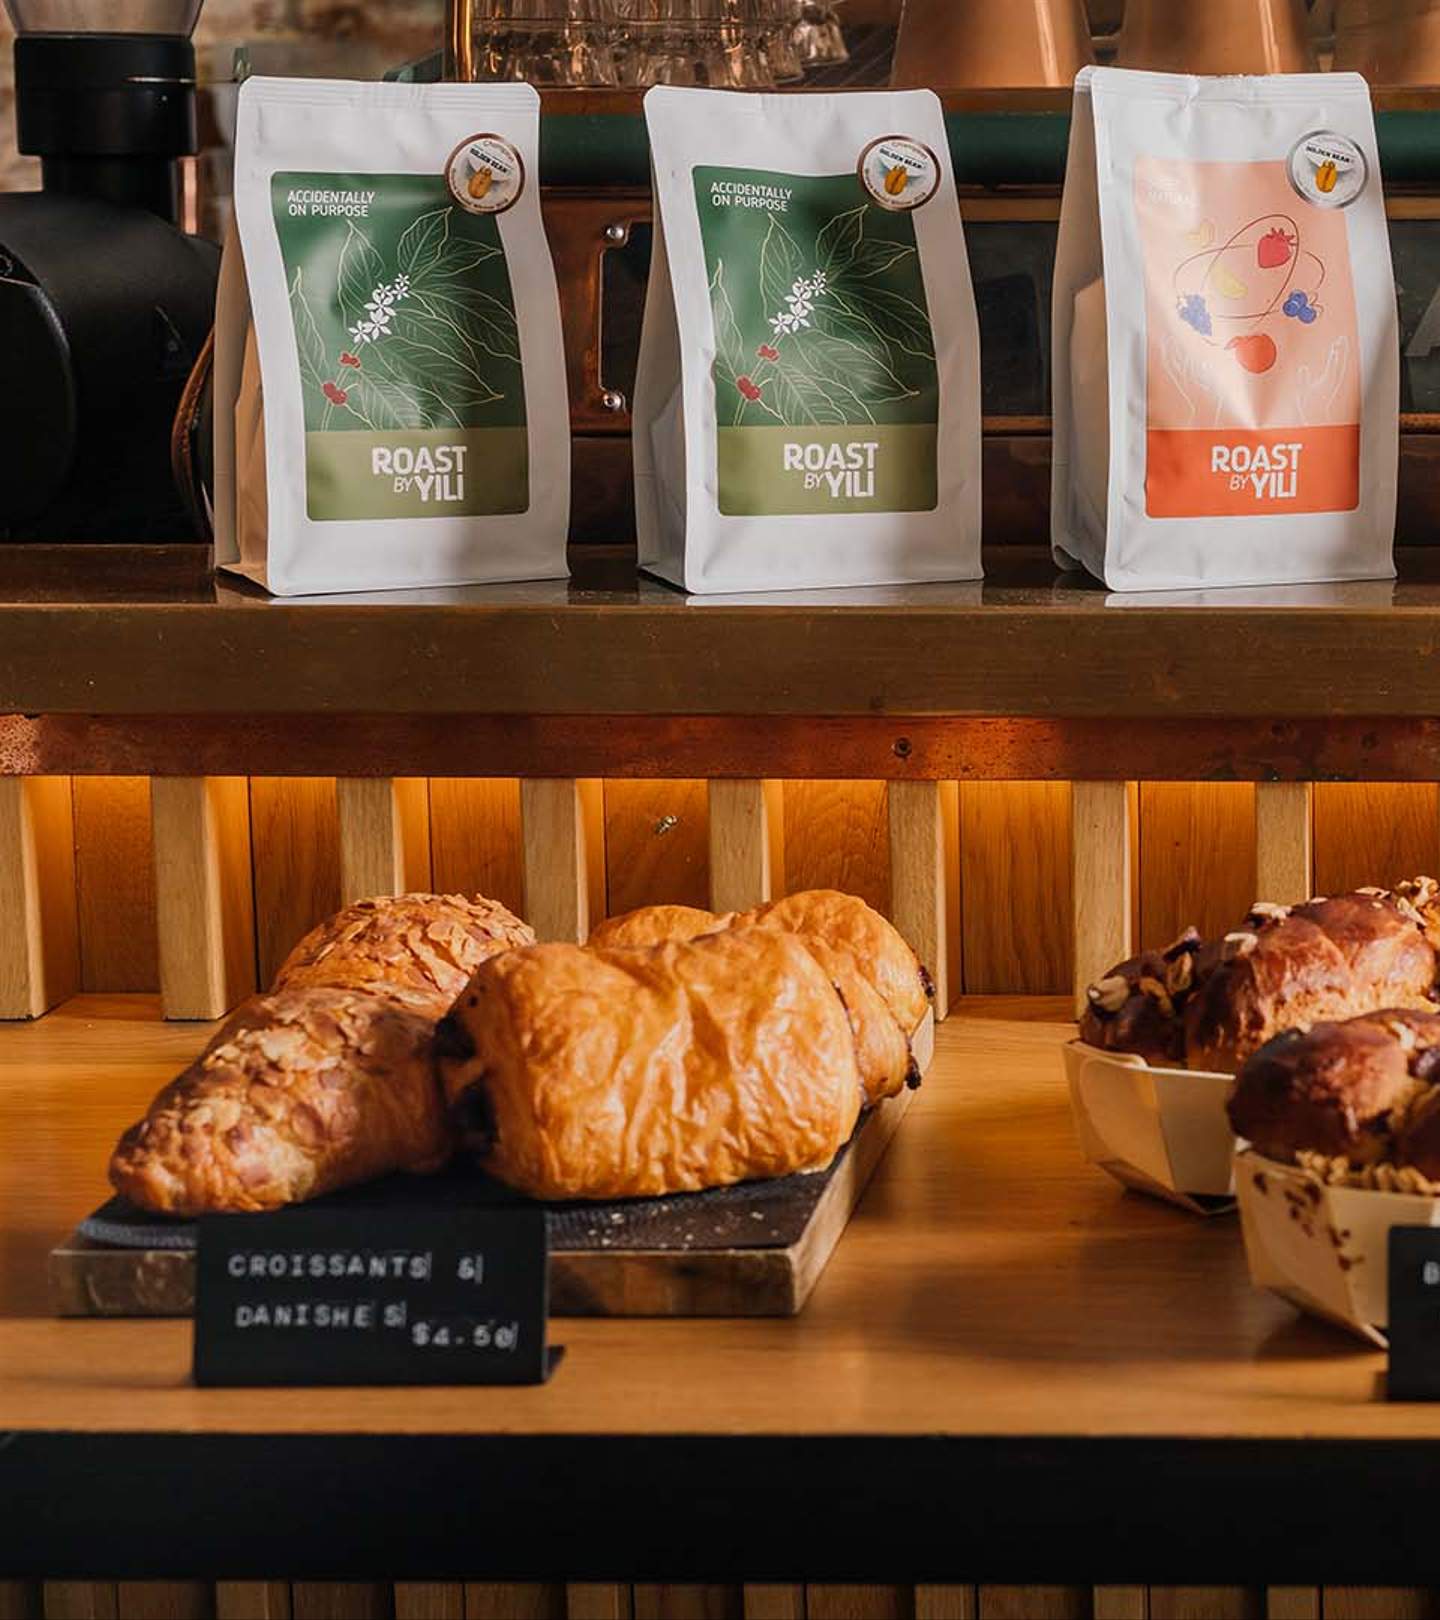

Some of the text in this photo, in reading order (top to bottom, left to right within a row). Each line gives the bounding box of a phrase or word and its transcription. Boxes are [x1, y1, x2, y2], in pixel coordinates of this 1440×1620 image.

[287, 189, 376, 204] ACCIDENTALLY
[710, 181, 793, 201] ACCIDENTALLY
[711, 194, 788, 212] ON PURPOSE
[288, 204, 369, 217] ON PURPOSE
[372, 446, 467, 475] ROAST
[783, 442, 879, 471] ROAST
[1211, 443, 1303, 473] ROAST
[393, 474, 464, 502] BY YILI
[804, 470, 875, 498] BY YILI
[1229, 470, 1297, 499] BY YILI
[227, 1254, 428, 1279] CROISSANTS
[411, 1322, 517, 1349] $4.50
